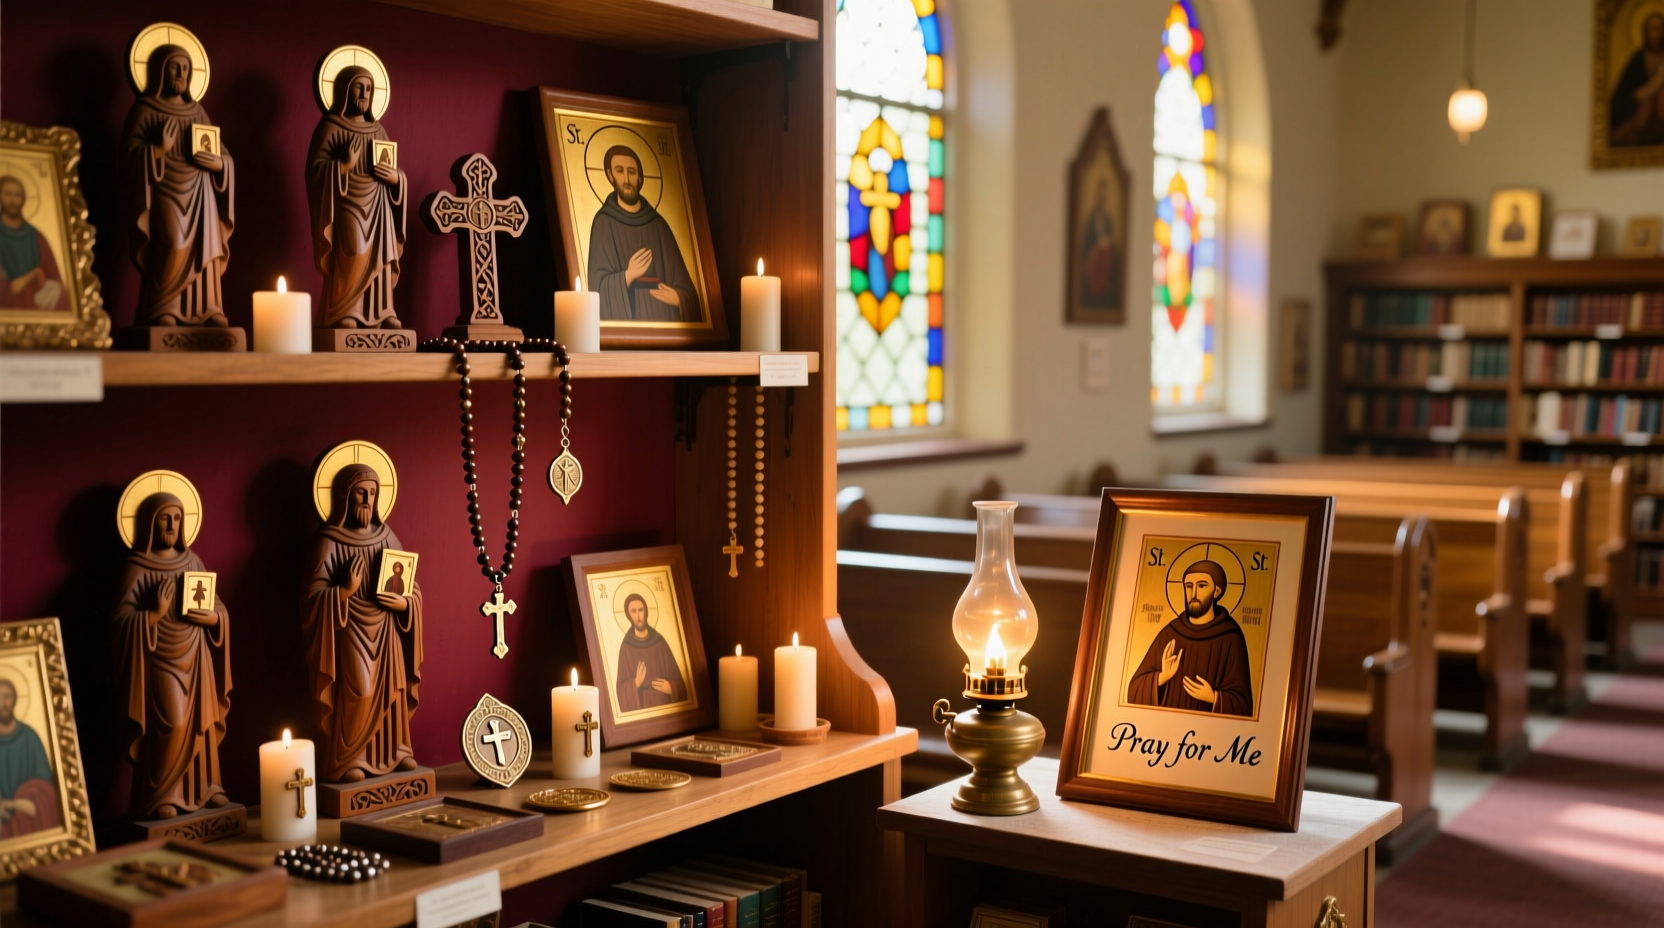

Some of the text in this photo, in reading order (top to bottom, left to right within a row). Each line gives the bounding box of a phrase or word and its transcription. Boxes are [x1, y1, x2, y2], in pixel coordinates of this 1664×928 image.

[1148, 547, 1166, 567] St.
[1250, 551, 1268, 571] St.
[1107, 722, 1262, 768] Pray for Me
